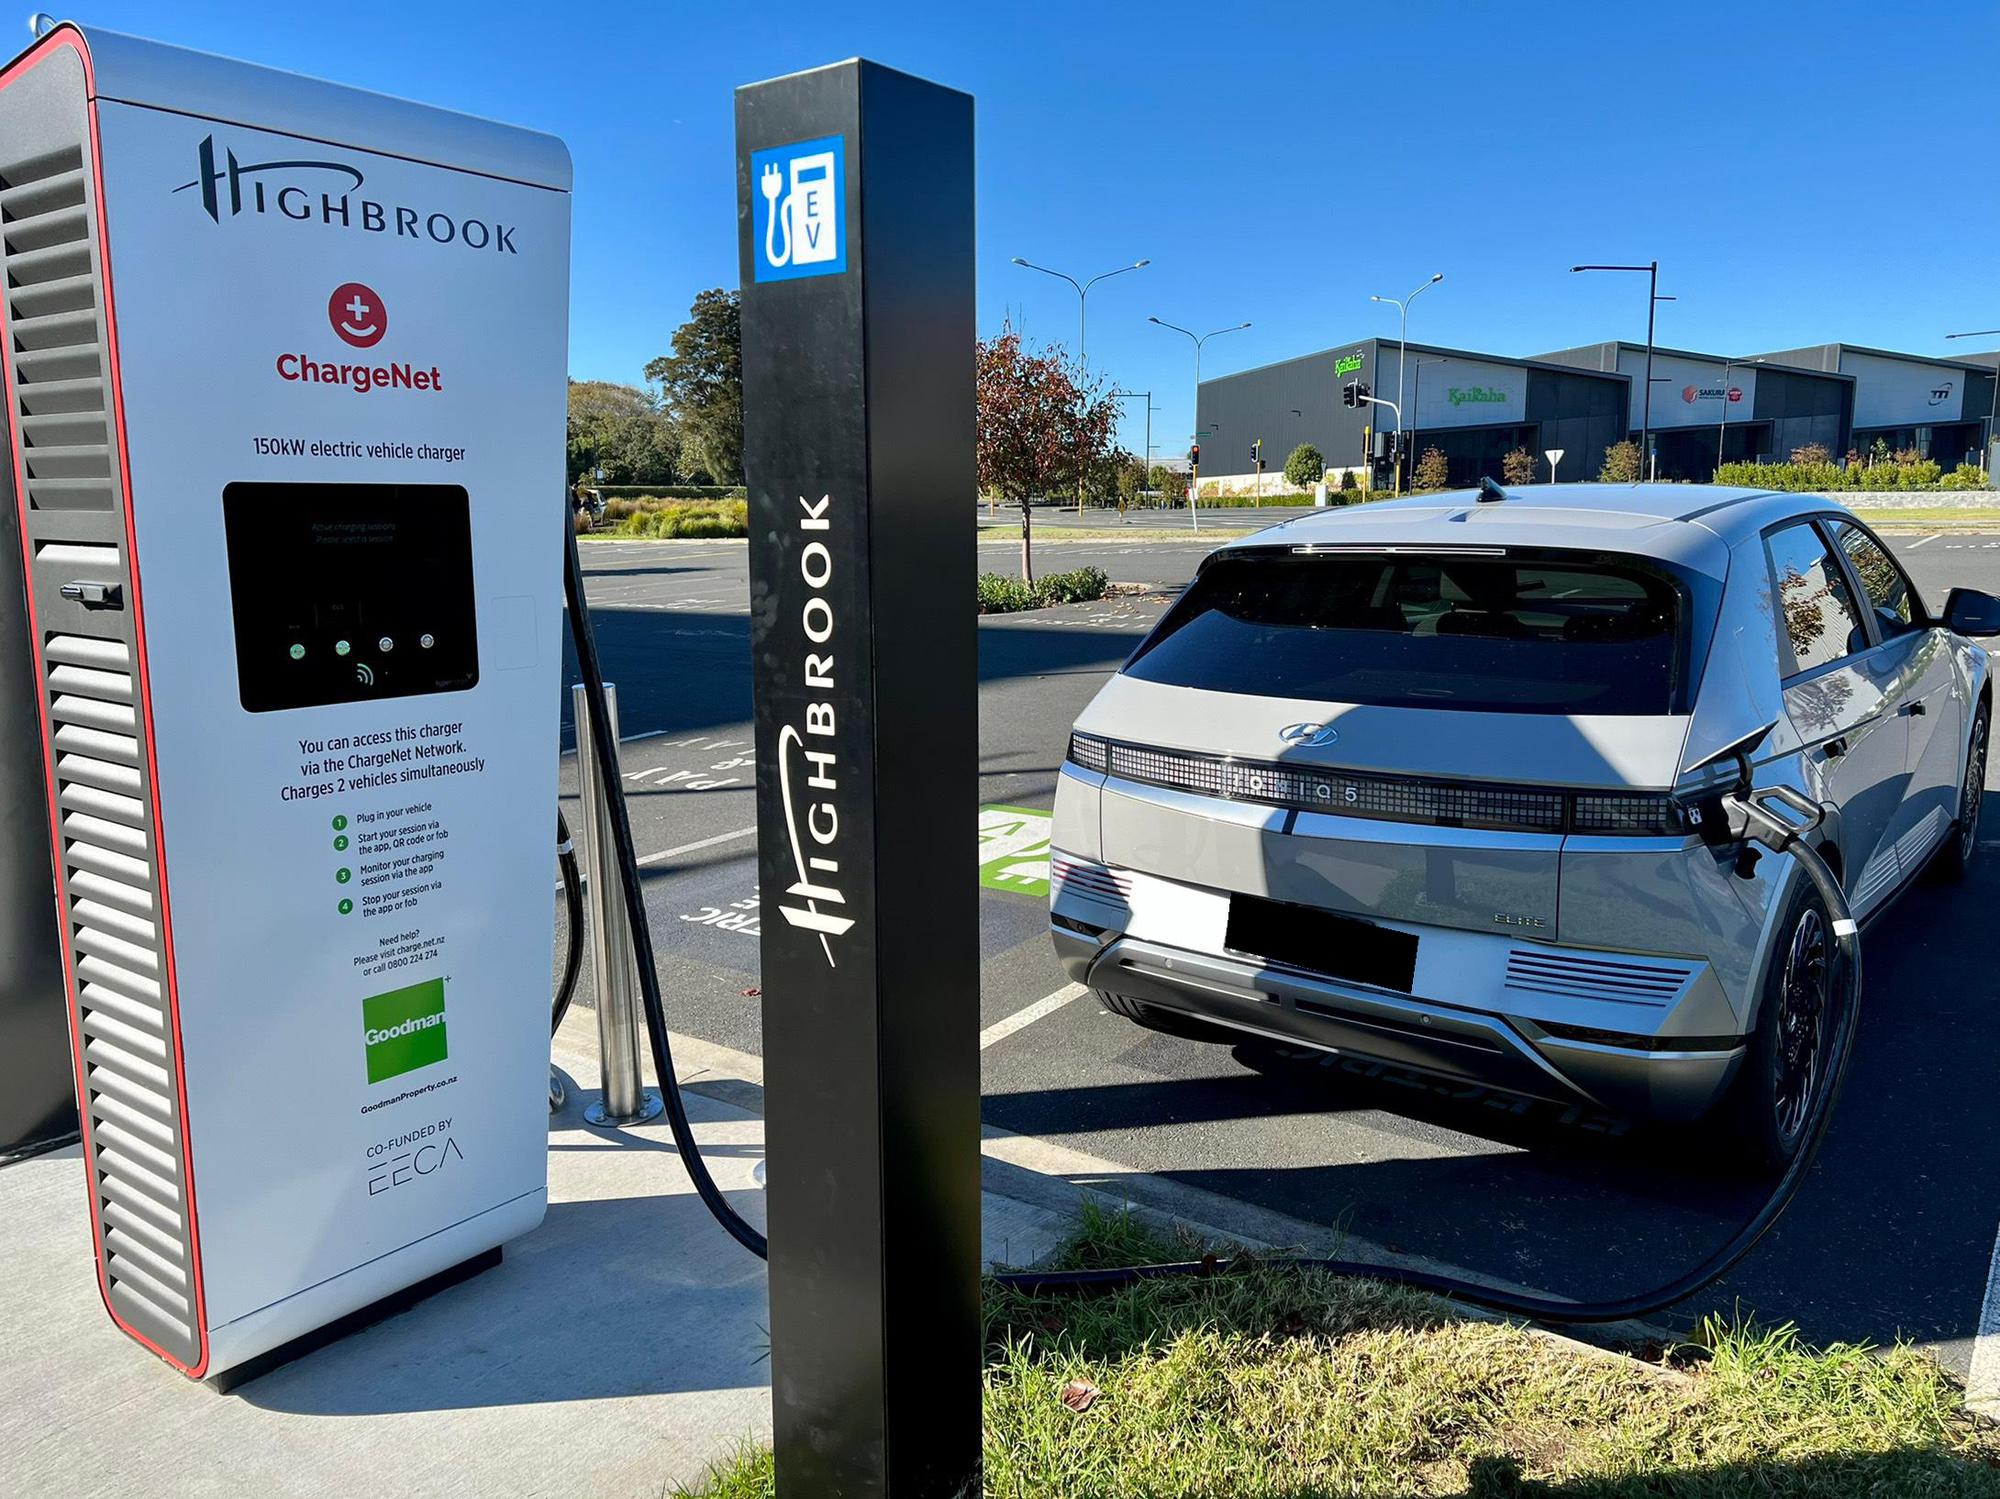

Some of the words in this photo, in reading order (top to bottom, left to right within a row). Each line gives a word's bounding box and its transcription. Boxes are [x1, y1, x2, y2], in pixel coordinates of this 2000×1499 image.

[172, 134, 518, 255] HIGHBROOK
[276, 353, 443, 393] ChargeNet
[253, 438, 305, 456] 150kW
[311, 440, 362, 458] electric
[366, 442, 414, 460] vehicle
[417, 444, 466, 463] charger
[299, 740, 324, 755] You
[327, 737, 349, 751] can
[353, 731, 392, 748] access
[395, 726, 417, 742] this
[420, 721, 463, 739] charger
[778, 494, 856, 968] HIGHBROOK
[301, 761, 320, 776] via
[324, 758, 344, 773] the
[348, 748, 412, 769] ChargeNet
[415, 740, 467, 760] Network.
[281, 781, 334, 801] Charges
[337, 778, 345, 792] 2
[349, 771, 397, 791] vehicles
[400, 757, 485, 783] simultaneously
[1345, 787, 1358, 802] 5
[356, 813, 375, 824] Plug
[377, 810, 384, 820] in
[386, 808, 403, 820] your
[405, 802, 432, 816] vehicle
[358, 831, 378, 843] Start
[379, 829, 397, 841] your
[398, 823, 427, 836] session
[428, 820, 440, 830] via
[359, 845, 372, 855] the
[374, 843, 392, 853] app,
[393, 837, 405, 848] QR
[406, 834, 425, 846] code
[426, 832, 434, 842] or
[436, 829, 449, 839] fob
[360, 860, 391, 875] Monitor
[392, 857, 410, 870] your
[411, 850, 444, 863] charging
[361, 873, 390, 887] session
[391, 870, 403, 880] via
[405, 866, 417, 877] the
[418, 864, 434, 876] app
[362, 895, 381, 906] Stop
[382, 891, 400, 903] your
[401, 885, 430, 897] session
[430, 880, 442, 890] via
[363, 907, 377, 918] the
[378, 904, 393, 916] app
[394, 900, 403, 910] or
[404, 897, 418, 908] fob
[1494, 912, 1545, 929] ELITE
[353, 953, 378, 967] Please
[379, 948, 395, 960] visit
[397, 936, 446, 955] charge.net.nz
[379, 934, 399, 947] Need
[400, 929, 420, 942] help?
[363, 968, 372, 977] or
[373, 963, 386, 974] call
[388, 957, 409, 970] 0800
[410, 953, 423, 965] 224
[424, 949, 438, 961] 274
[365, 1011, 447, 1046] Goodman
[360, 1076, 458, 1115] GoodmanProperty.co.nz
[366, 1124, 436, 1158] CO-FUNDED
[438, 1117, 453, 1132] BY
[368, 1137, 463, 1196] EECA
